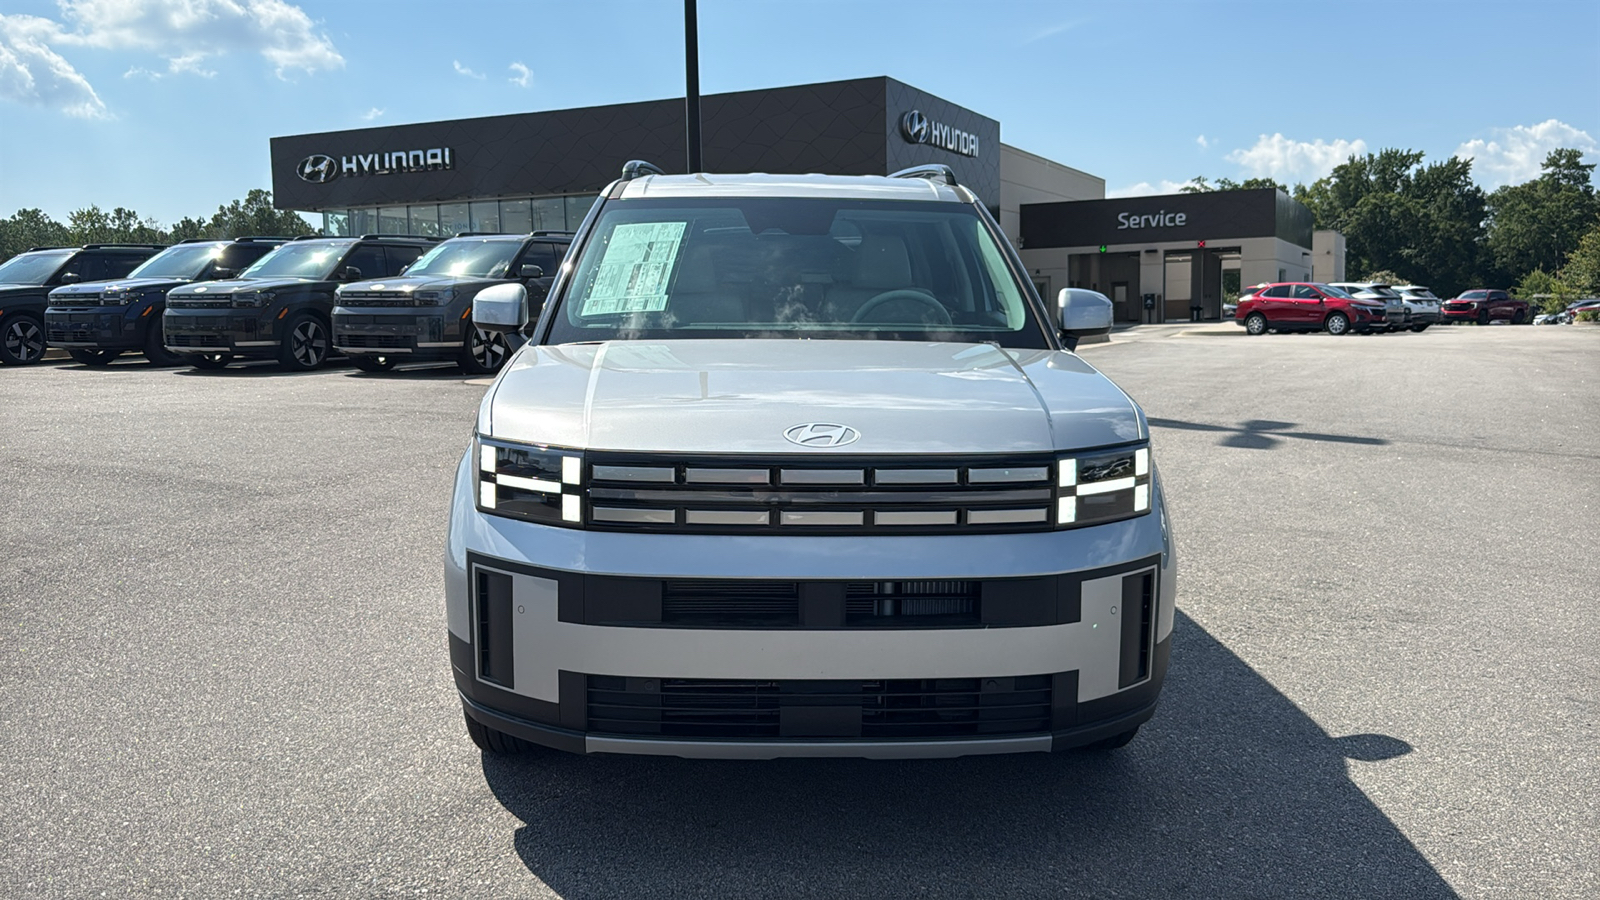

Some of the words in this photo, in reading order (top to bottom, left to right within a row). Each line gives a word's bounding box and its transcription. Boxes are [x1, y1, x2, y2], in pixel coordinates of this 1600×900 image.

[931, 120, 979, 157] HYUNDAI
[342, 147, 450, 176] HYUNDAI
[1117, 210, 1187, 229] Service
